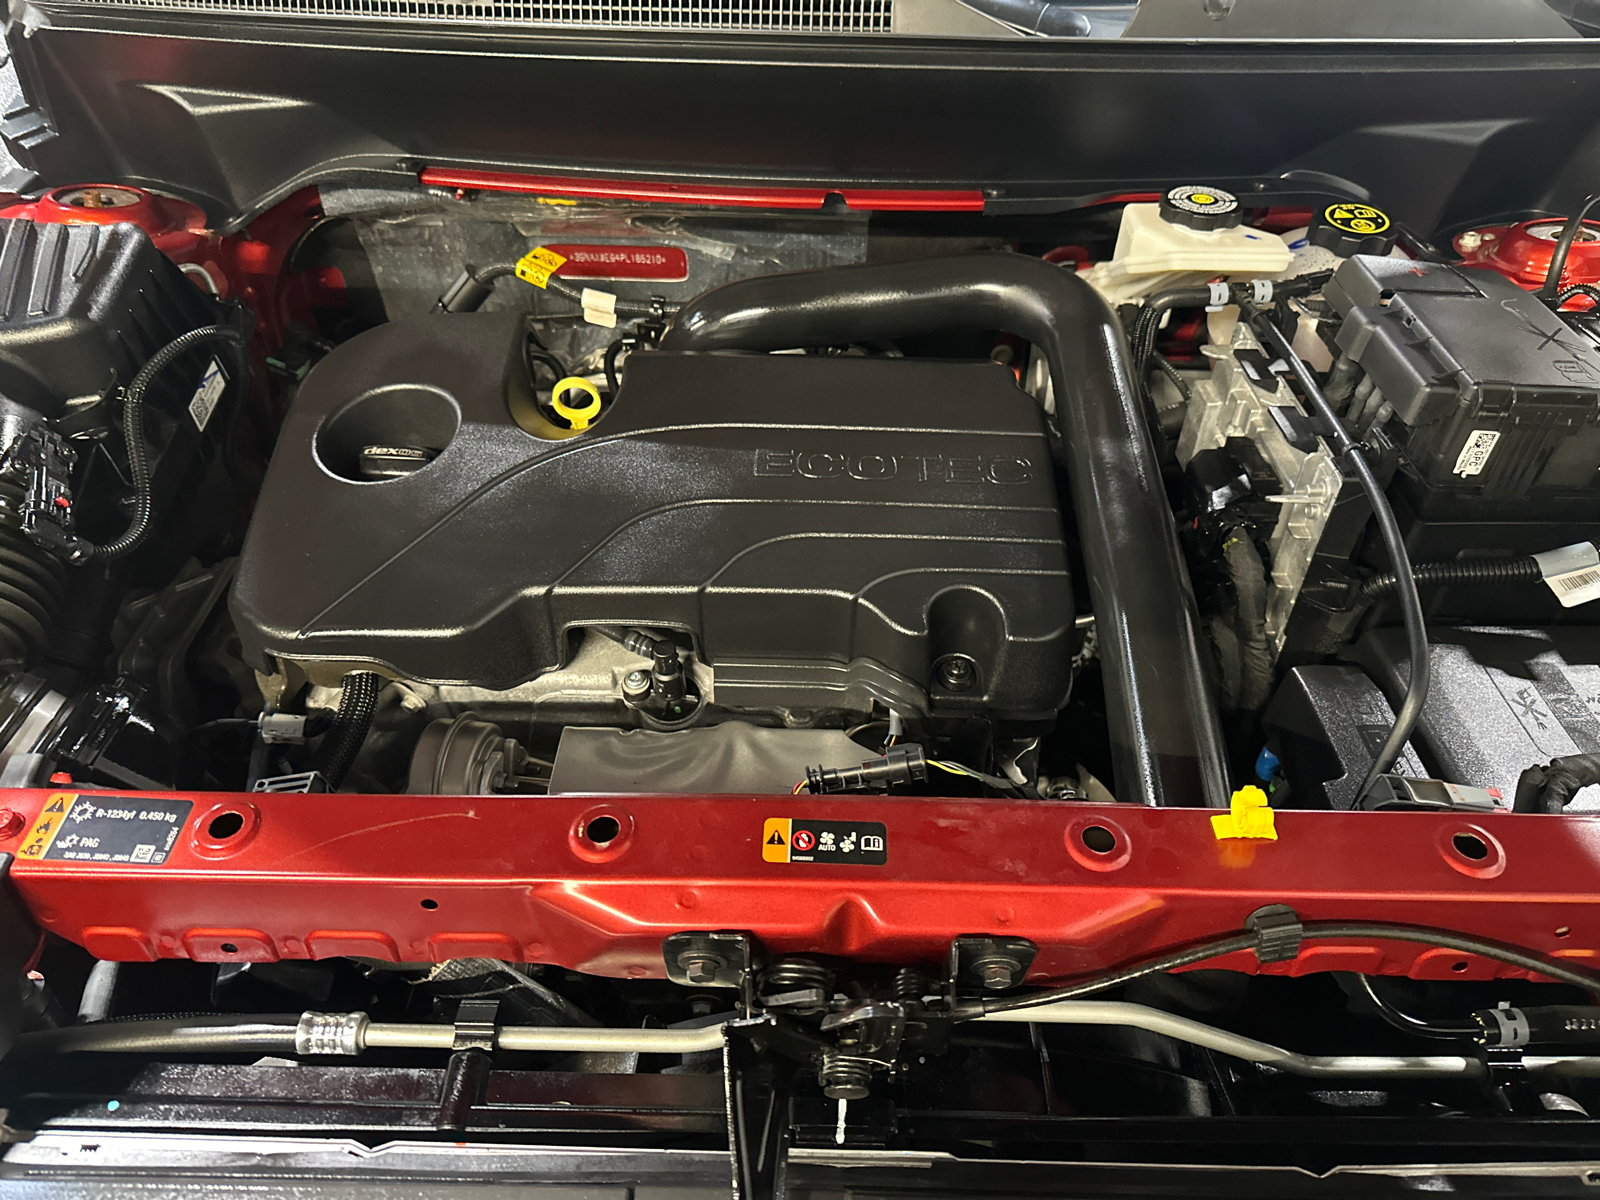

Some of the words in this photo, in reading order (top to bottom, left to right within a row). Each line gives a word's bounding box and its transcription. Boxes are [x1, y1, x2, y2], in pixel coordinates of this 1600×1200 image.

[1469, 451, 1484, 466] GPC
[753, 448, 1033, 485] ECOTEC
[95, 809, 136, 820] R-1234yf
[139, 809, 164, 821] 0.450
[164, 811, 177, 823] kg
[79, 836, 100, 848] PAG
